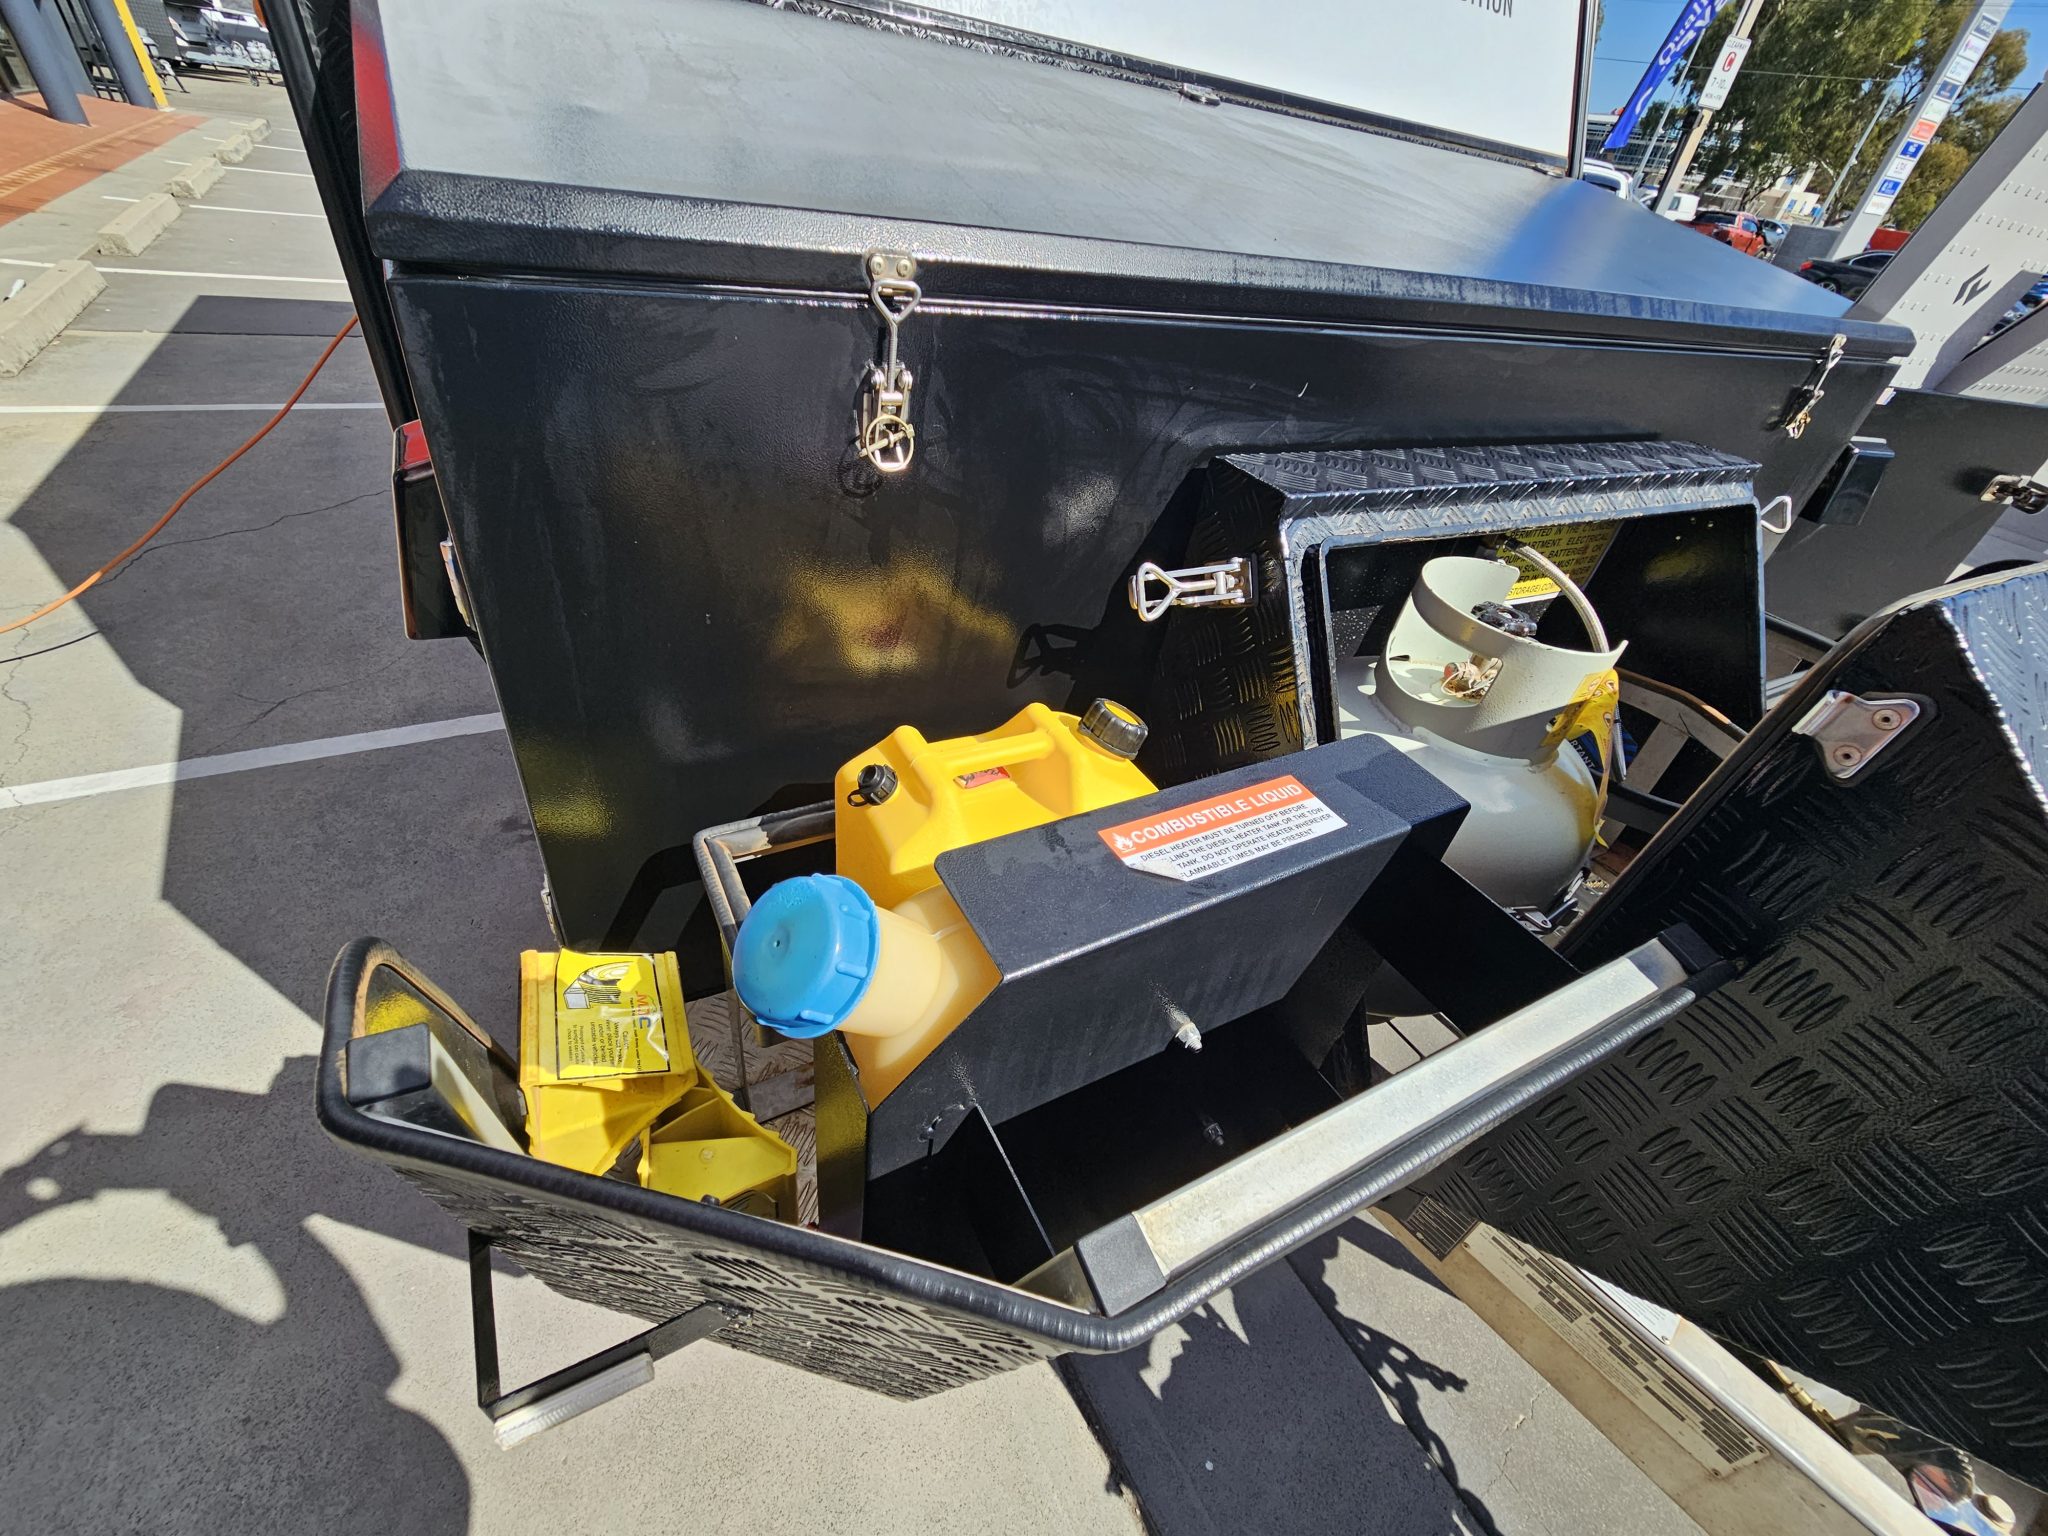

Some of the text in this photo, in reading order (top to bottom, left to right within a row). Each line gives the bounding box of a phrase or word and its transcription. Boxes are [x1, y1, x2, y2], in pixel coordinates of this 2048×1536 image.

[1131, 783, 1303, 844] COMBUSTIBLE LIQUID
[1140, 803, 1309, 862] DIESEL HEATER MUST BE TURNED OFF BEFORE
[1189, 845, 1207, 856] THE
[1206, 837, 1235, 850] DIESEL
[1234, 828, 1262, 841] HEATER
[1262, 821, 1282, 832] TANK
[1281, 816, 1295, 825] OR
[1294, 812, 1309, 822] THE
[1307, 807, 1325, 817] TOW
[1201, 853, 1215, 862] DO
[1214, 847, 1233, 858] NOT
[1231, 836, 1267, 851] OPERATE
[1266, 826, 1295, 839] HEATER
[1295, 813, 1333, 830] WHEREVER
[1228, 849, 1256, 862] FUMES
[1254, 843, 1271, 853] MAY
[1270, 839, 1283, 848] BE
